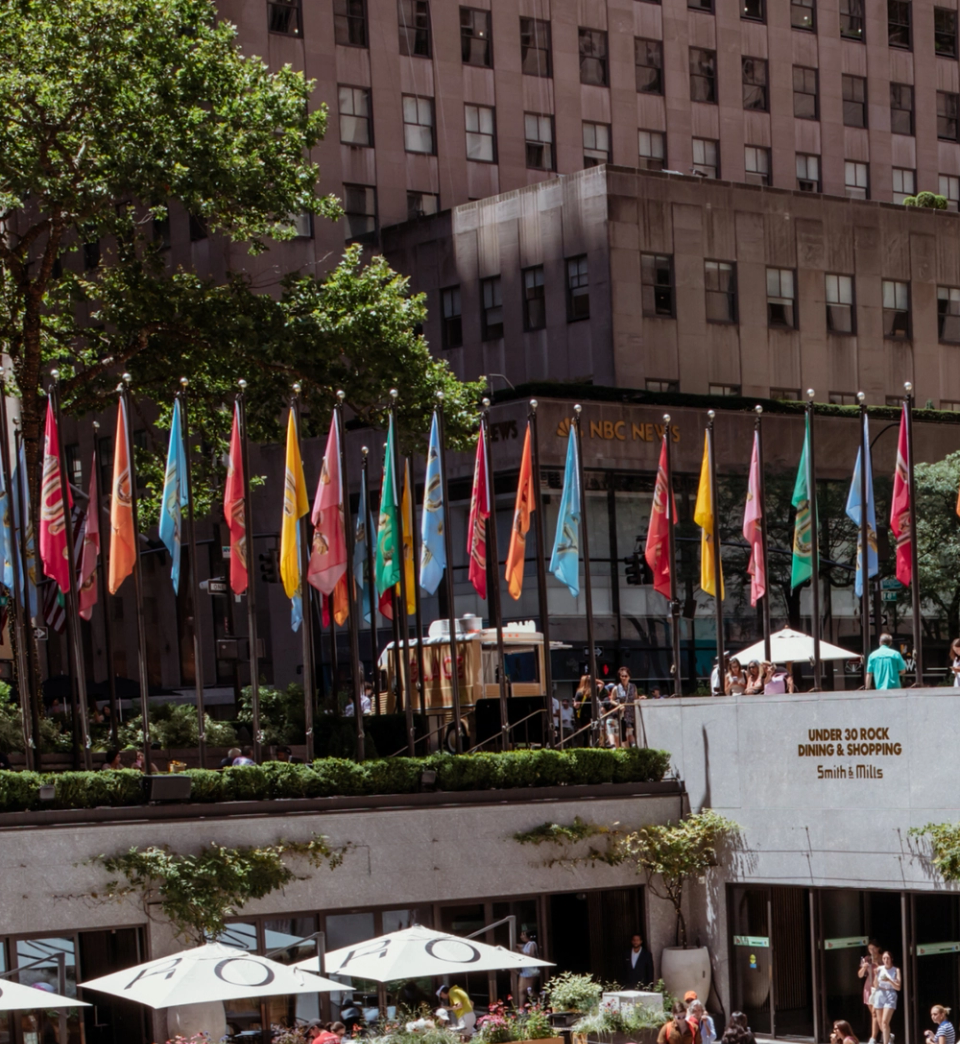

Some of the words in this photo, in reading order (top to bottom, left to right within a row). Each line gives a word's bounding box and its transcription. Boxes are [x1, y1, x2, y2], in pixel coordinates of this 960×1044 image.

[491, 420, 519, 443] EWS
[590, 420, 626, 440] NBC
[632, 423, 681, 443] NEWS
[808, 728, 843, 742] UNDER
[844, 728, 859, 741] 30
[860, 727, 890, 740] ROCK
[798, 743, 835, 757] DINING
[836, 743, 845, 756] &
[847, 742, 902, 756] SHOPPING
[817, 764, 847, 779] Smith
[856, 764, 884, 779] Mills
